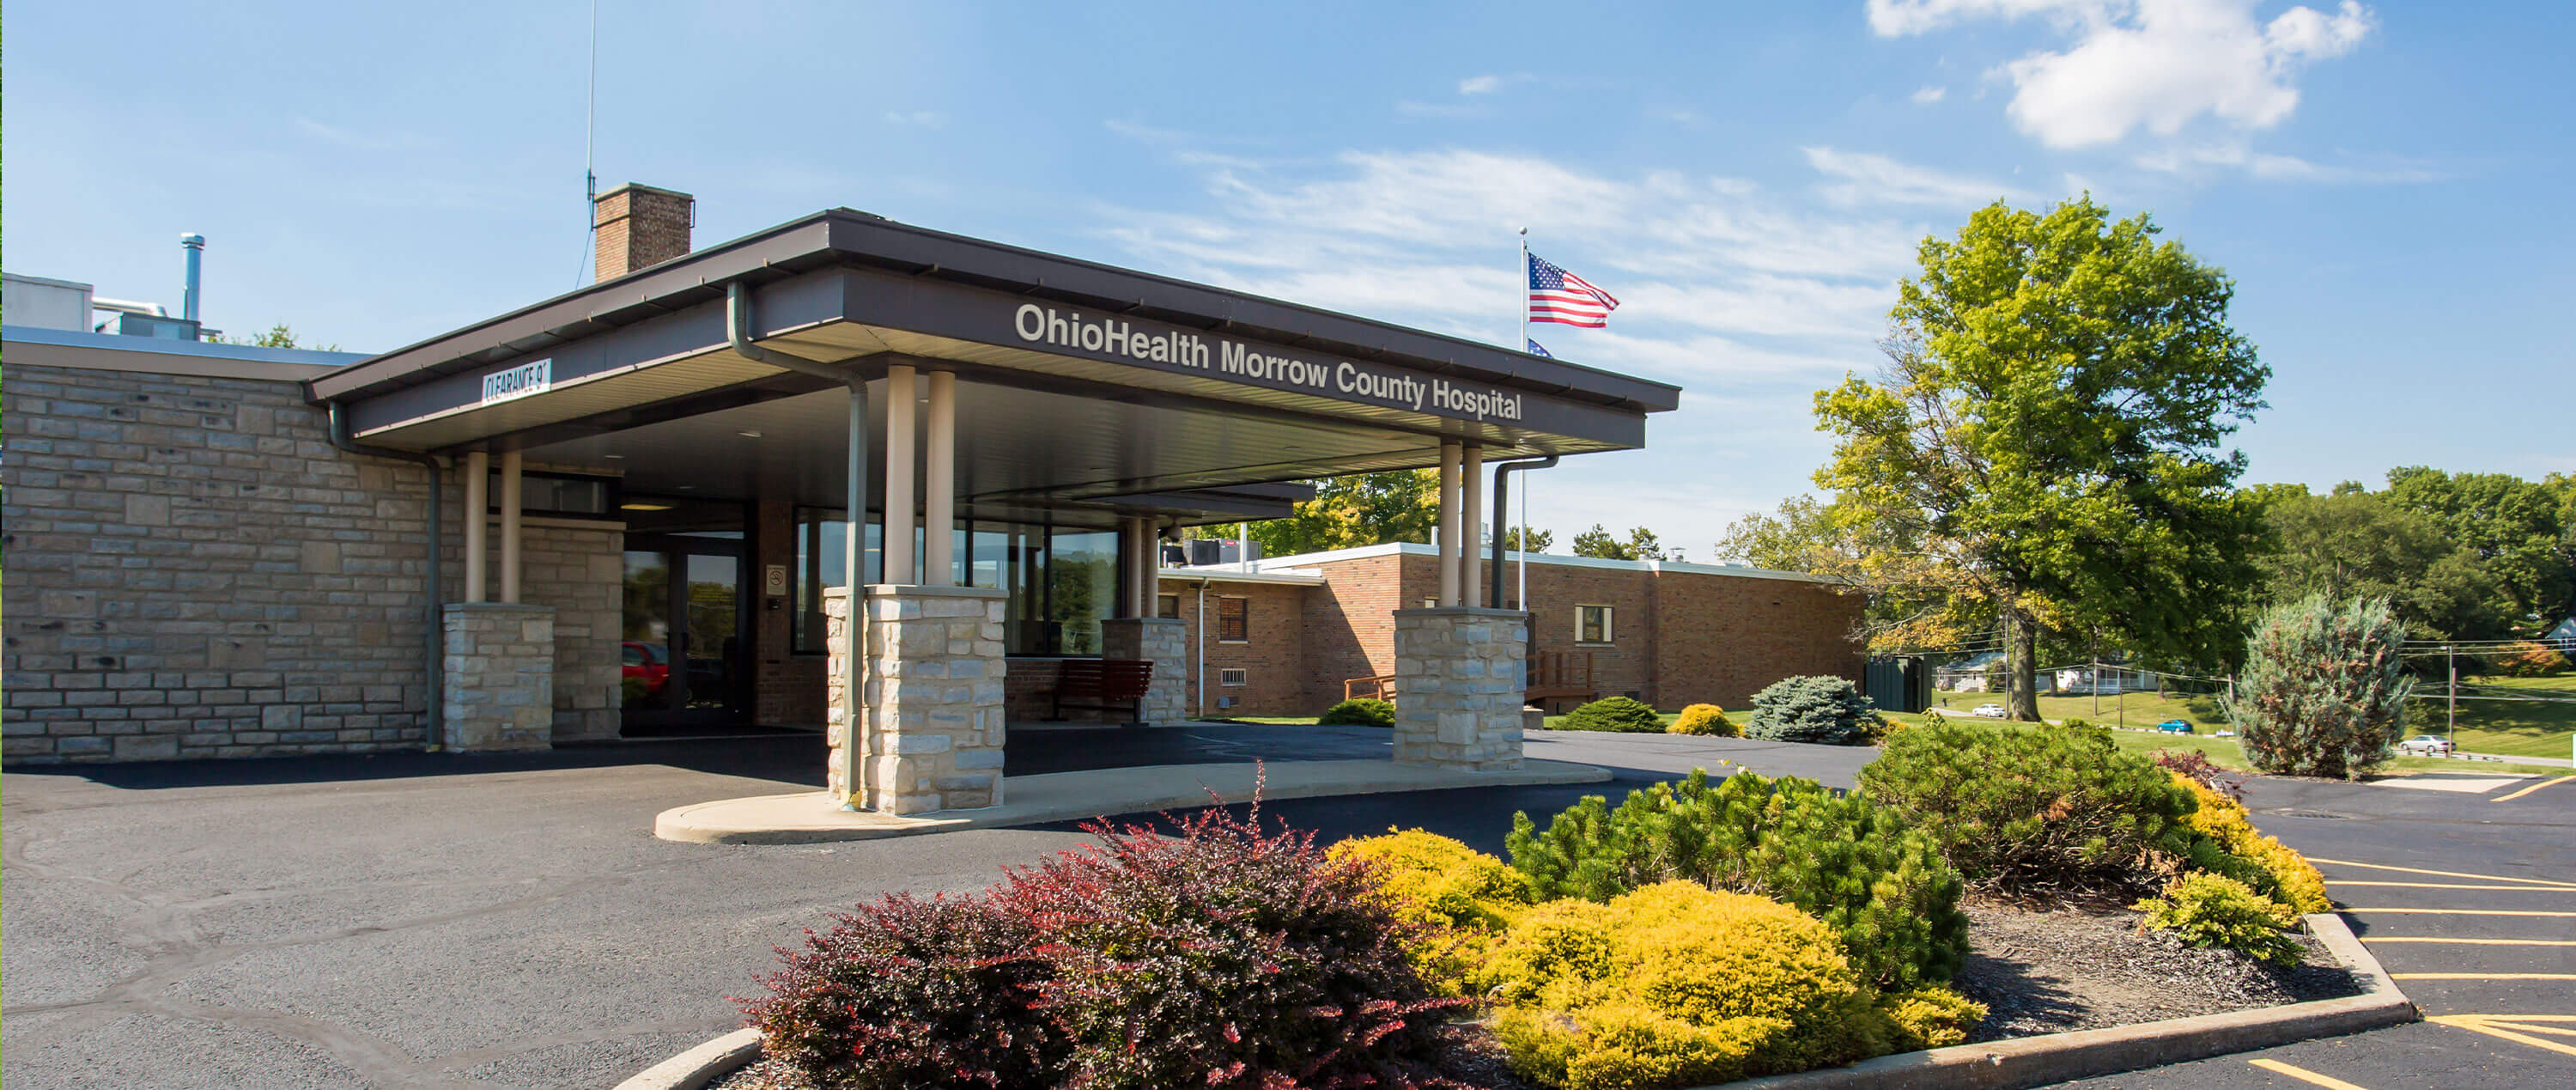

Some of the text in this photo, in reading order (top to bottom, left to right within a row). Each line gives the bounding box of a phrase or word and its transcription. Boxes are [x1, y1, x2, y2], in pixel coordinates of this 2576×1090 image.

[486, 367, 533, 402] CLEARANCE
[1016, 303, 1522, 421] OhioHealth Morrow County Hospital
